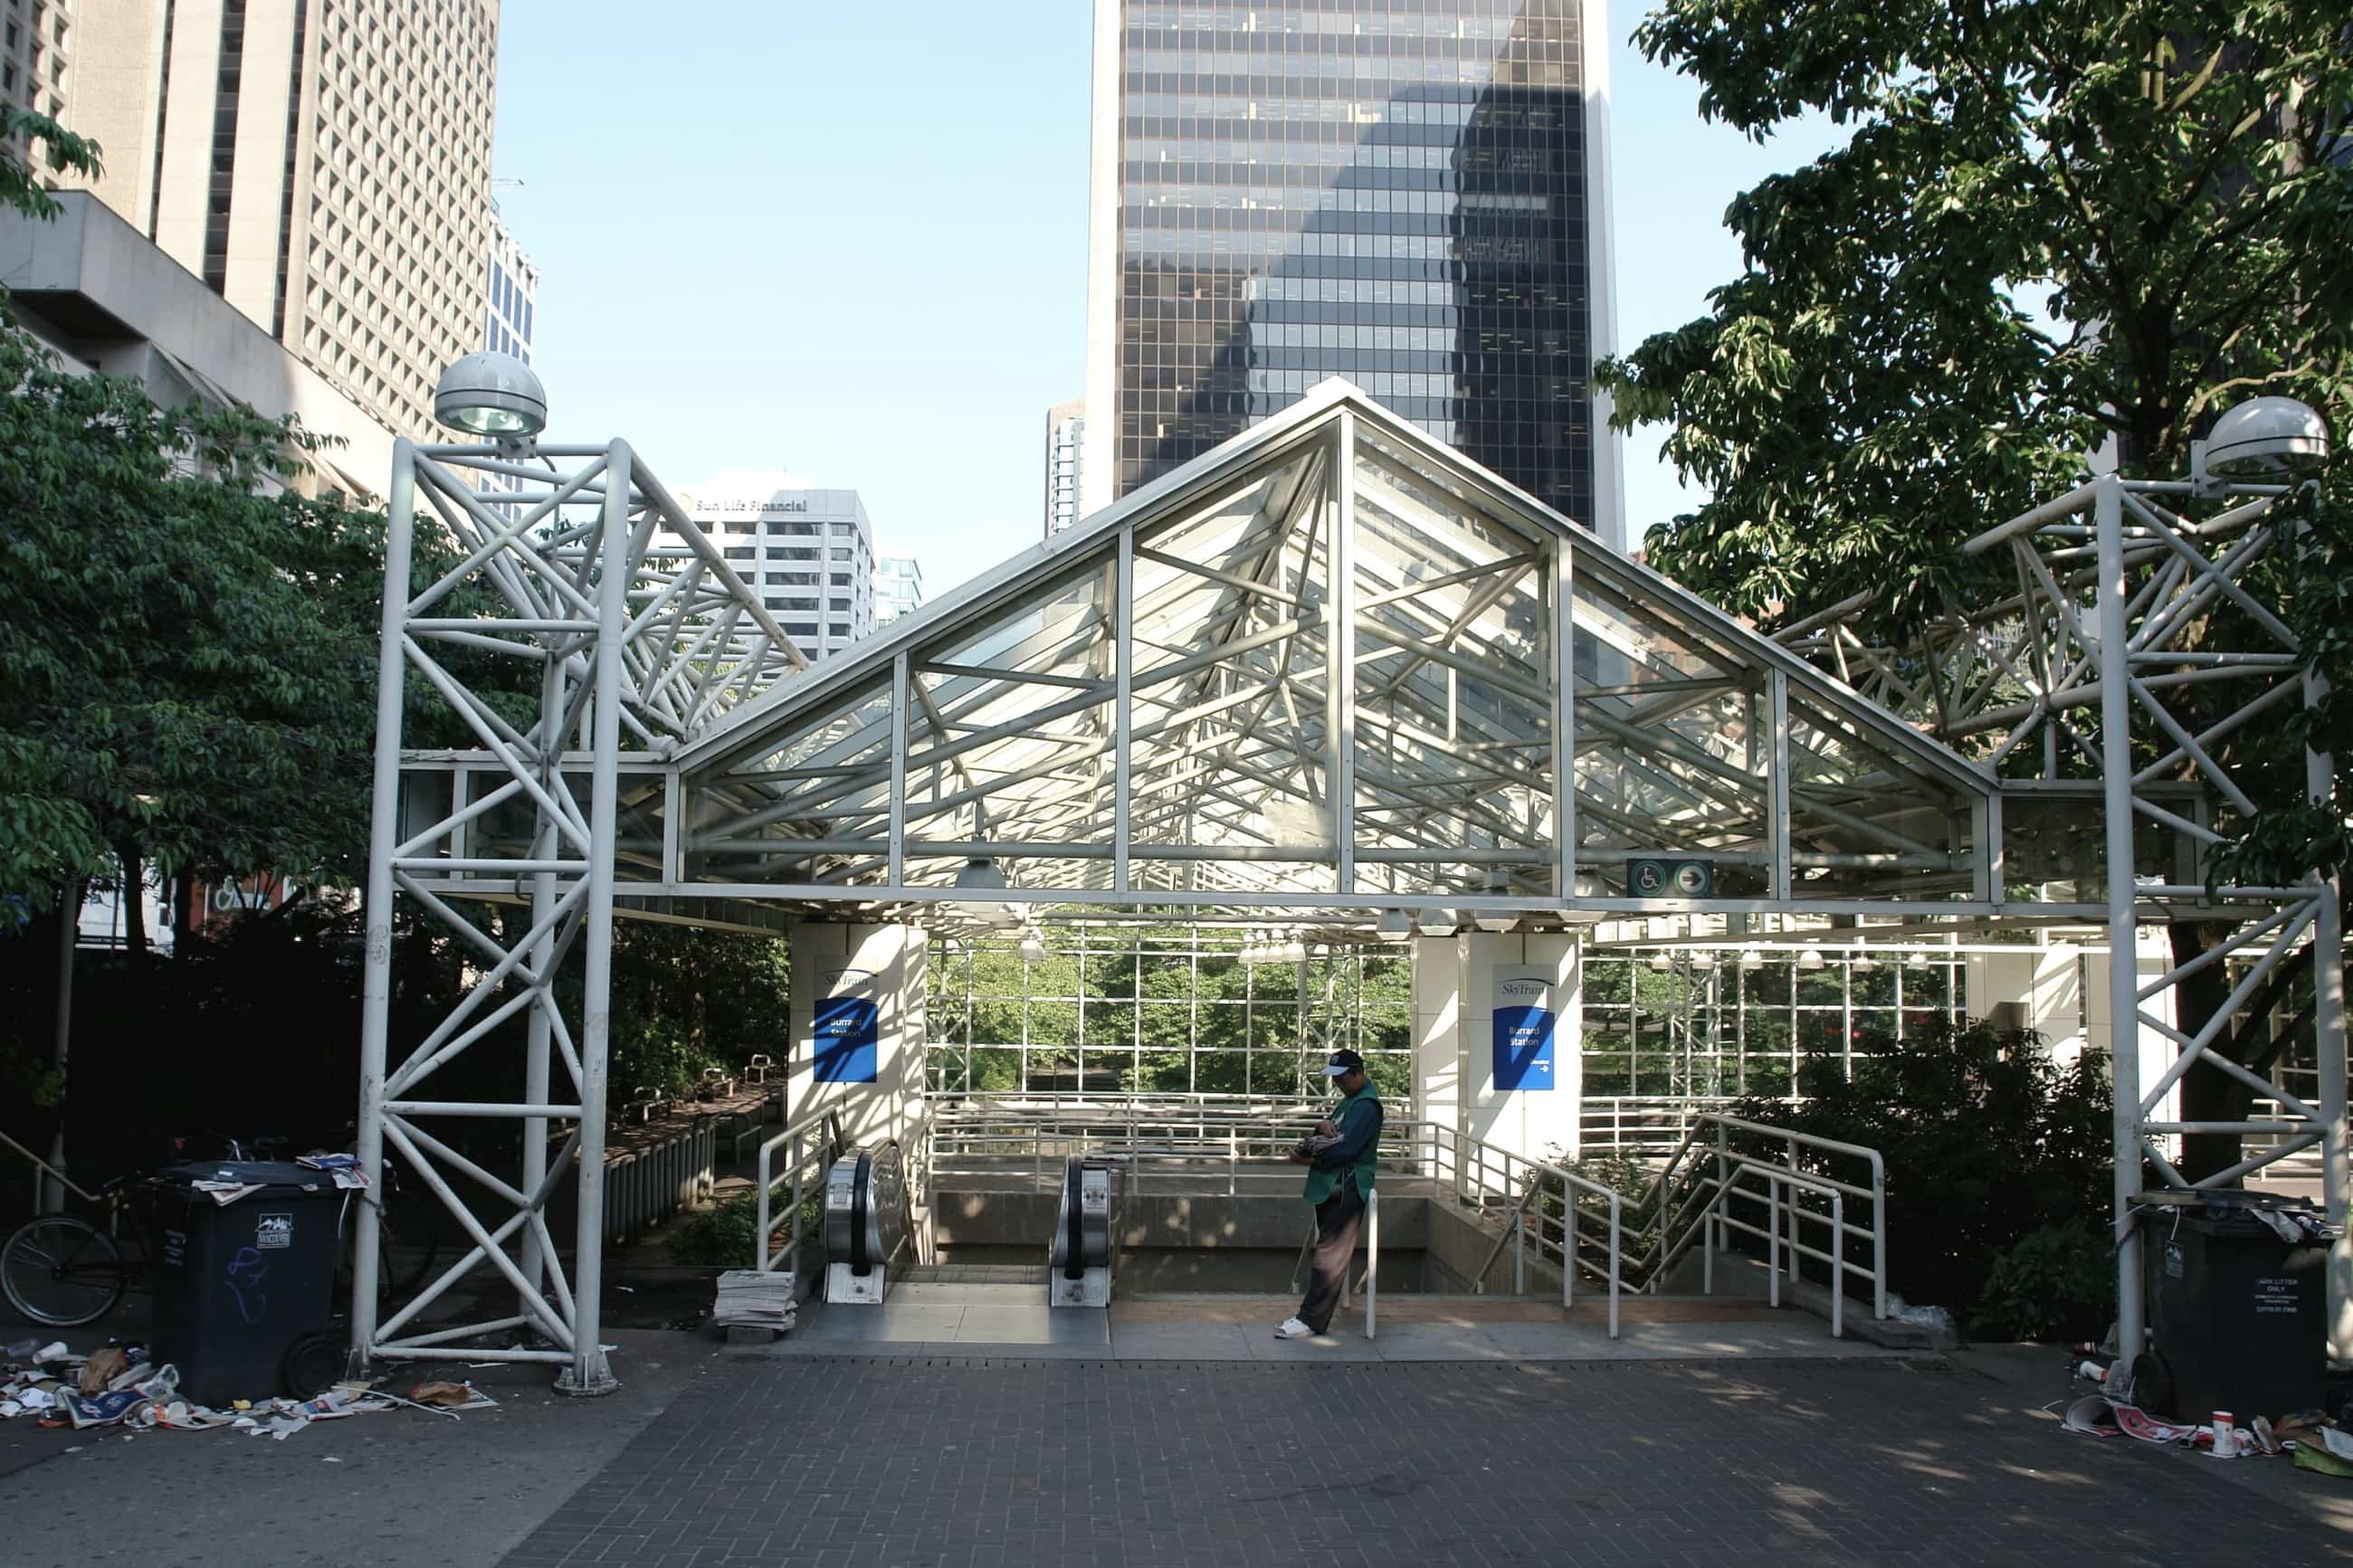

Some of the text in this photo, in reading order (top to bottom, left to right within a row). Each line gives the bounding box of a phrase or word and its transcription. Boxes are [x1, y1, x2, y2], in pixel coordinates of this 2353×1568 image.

[695, 499, 807, 512] Sun Life Financial
[1502, 984, 1545, 995] SkyTrain
[1509, 1026, 1540, 1035] Burrard
